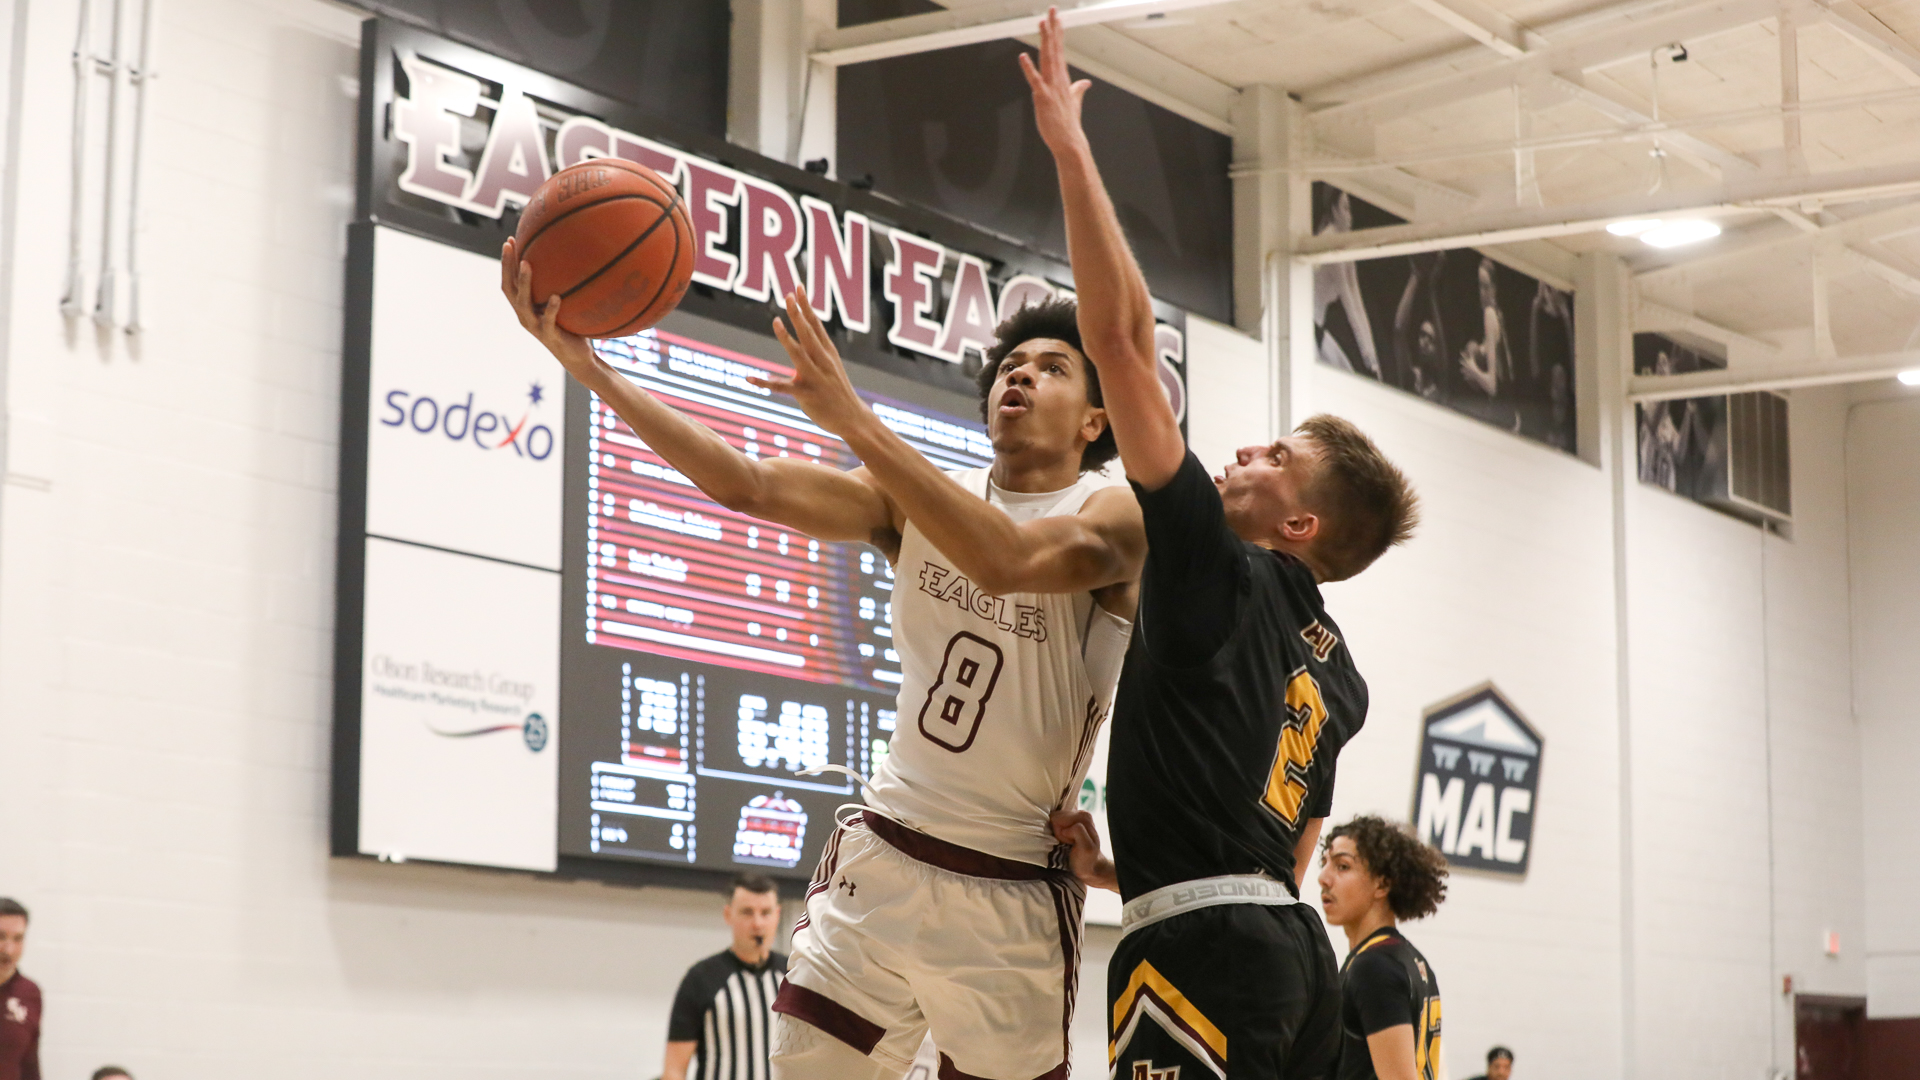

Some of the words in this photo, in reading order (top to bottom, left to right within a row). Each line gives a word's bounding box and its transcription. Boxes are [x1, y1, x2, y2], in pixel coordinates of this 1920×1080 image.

[380, 389, 554, 461] sodexo
[919, 561, 1047, 642] EAGLES
[1300, 619, 1338, 663] AU
[918, 631, 1004, 753] 8
[1259, 664, 1329, 831] 2
[1417, 772, 1532, 864] MAC
[1172, 882, 1270, 906] UNDER
